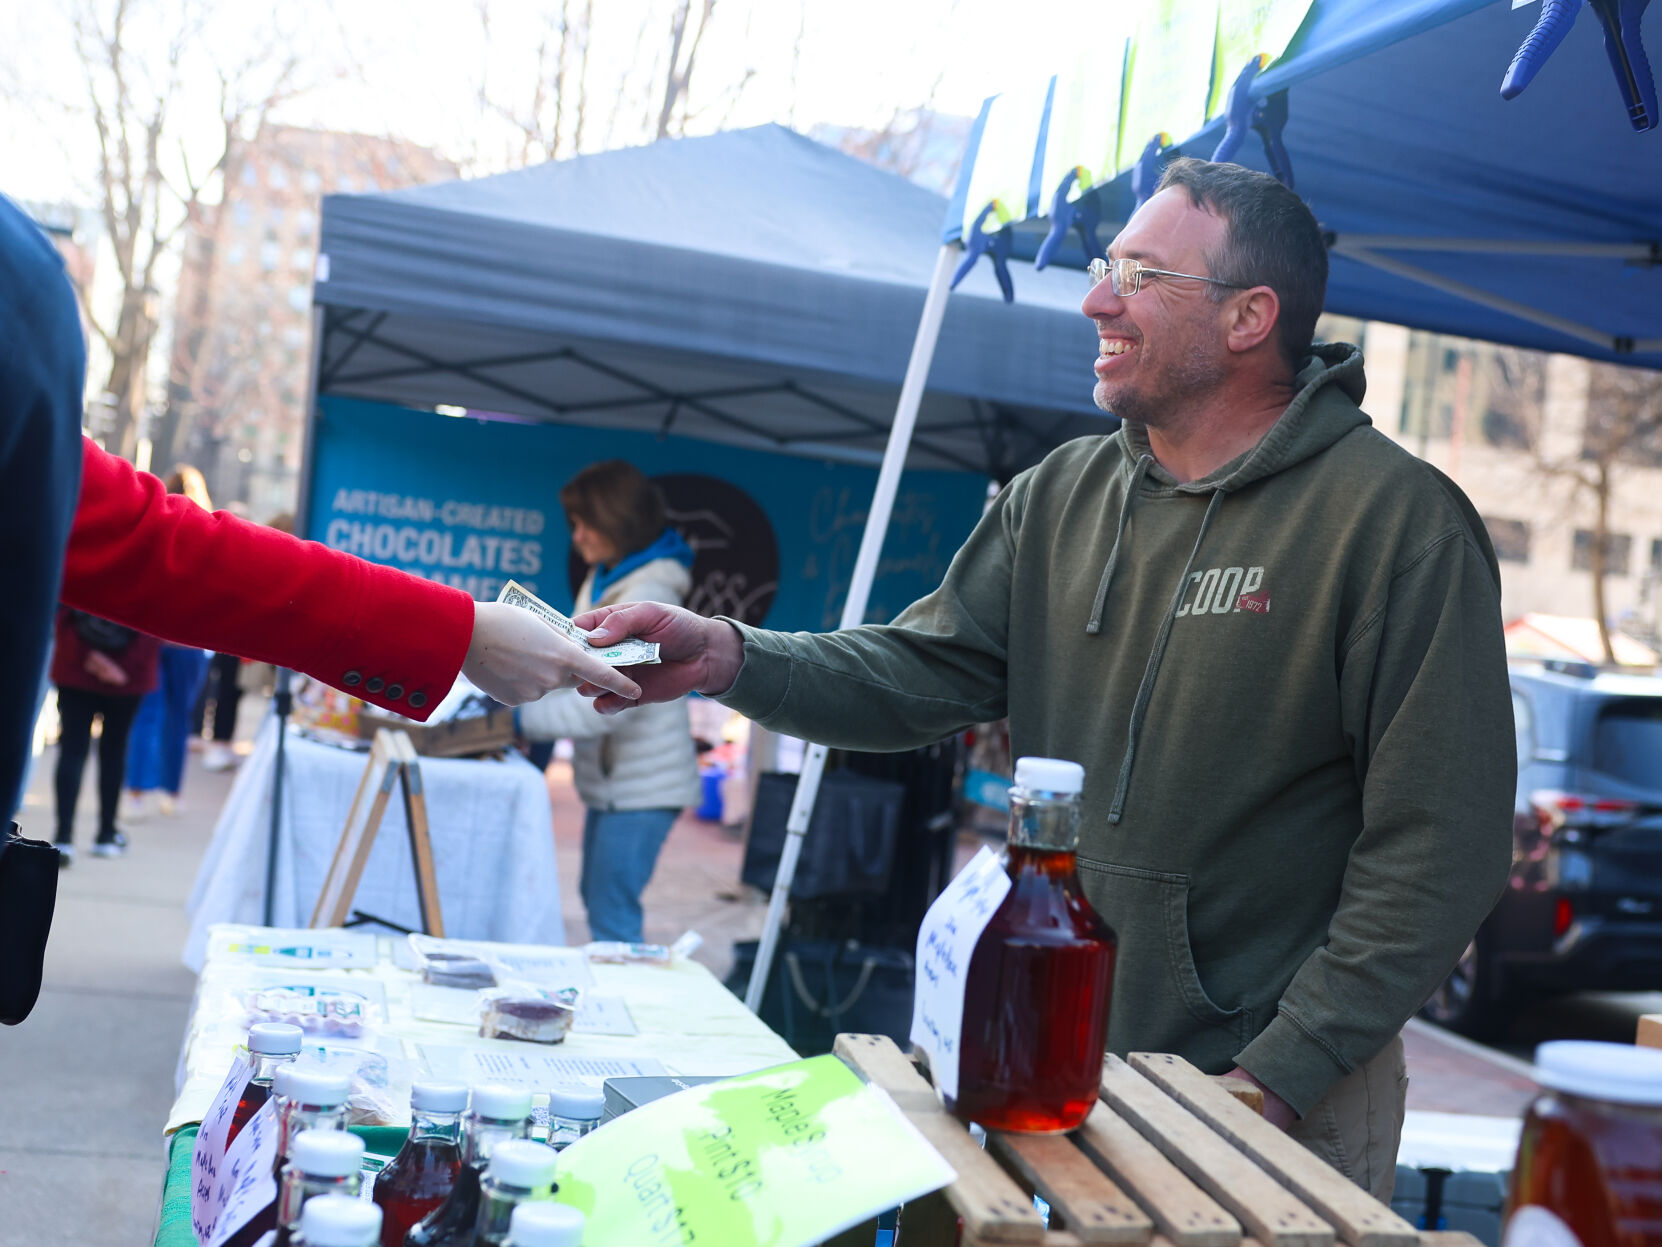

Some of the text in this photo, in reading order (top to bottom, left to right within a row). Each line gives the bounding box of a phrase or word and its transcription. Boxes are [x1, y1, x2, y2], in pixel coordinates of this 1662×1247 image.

[332, 488, 545, 536] ARTISAN-CREATED
[327, 518, 543, 576] CHOCOLATES
[1175, 566, 1265, 618] COOP
[761, 1088, 812, 1136] Maple
[698, 1126, 739, 1167] Pint
[623, 1154, 671, 1218] Quart
